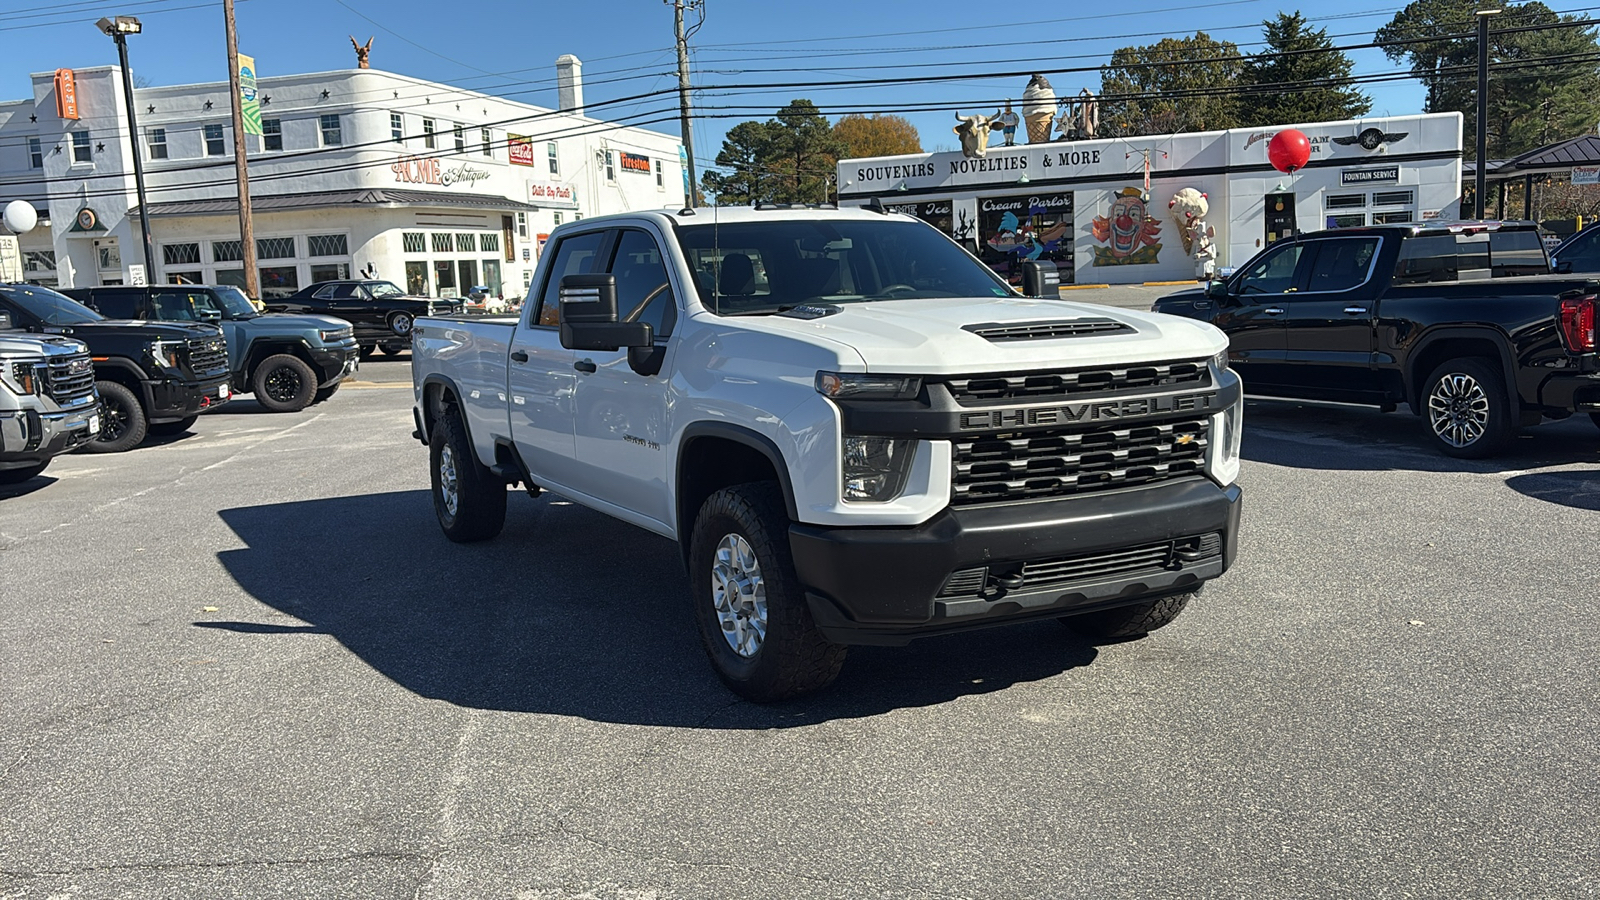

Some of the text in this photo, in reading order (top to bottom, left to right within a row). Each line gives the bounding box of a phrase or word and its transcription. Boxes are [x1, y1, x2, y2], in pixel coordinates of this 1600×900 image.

[64, 72, 75, 115] ACME
[391, 154, 441, 185] ACME
[857, 150, 1101, 181] SOUVENIRS NOVELTIES & MORE
[1344, 170, 1397, 181] FOUNTAIN SERVICE
[982, 196, 1071, 212] Cream Parlor
[133, 277, 143, 285] 25
[959, 391, 1217, 430] CHEVROLET
